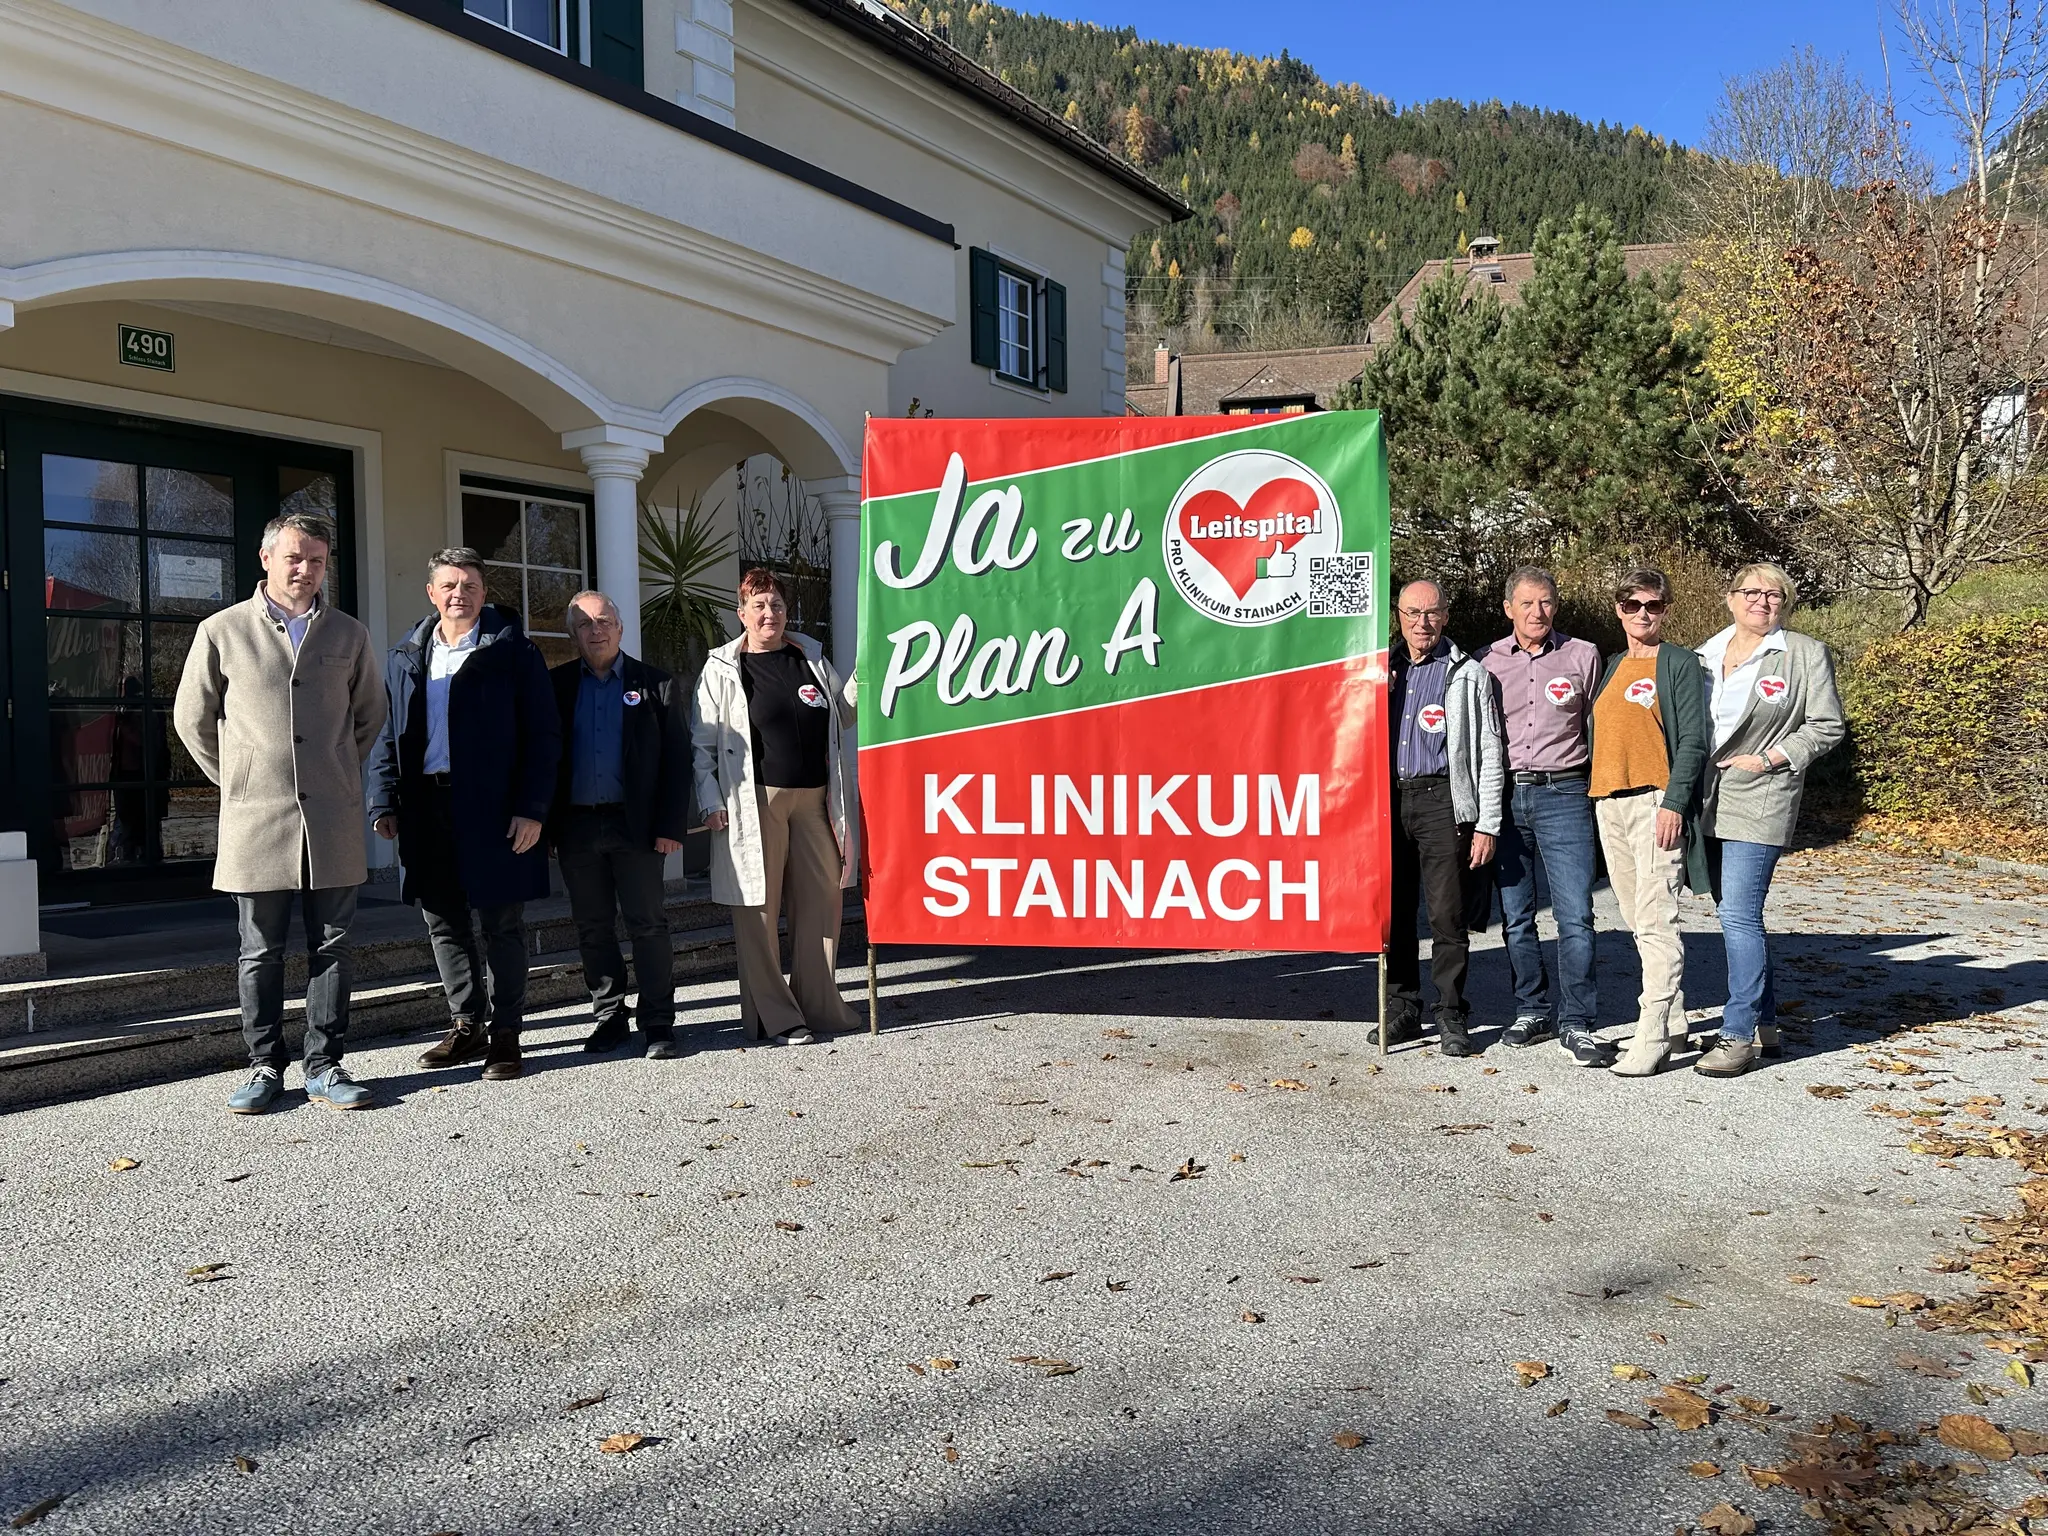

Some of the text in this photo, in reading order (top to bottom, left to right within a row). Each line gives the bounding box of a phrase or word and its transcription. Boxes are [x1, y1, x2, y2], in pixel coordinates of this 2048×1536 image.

[127, 331, 167, 357] 490
[874, 451, 1143, 589] Ja zu
[1189, 509, 1322, 542] Leitspital
[1170, 538, 1303, 619] PRO KLINIKUM STAINACH
[880, 576, 1165, 719] Plan A
[924, 773, 1321, 837] KLINIKUM
[922, 856, 1320, 921] STAINACH
